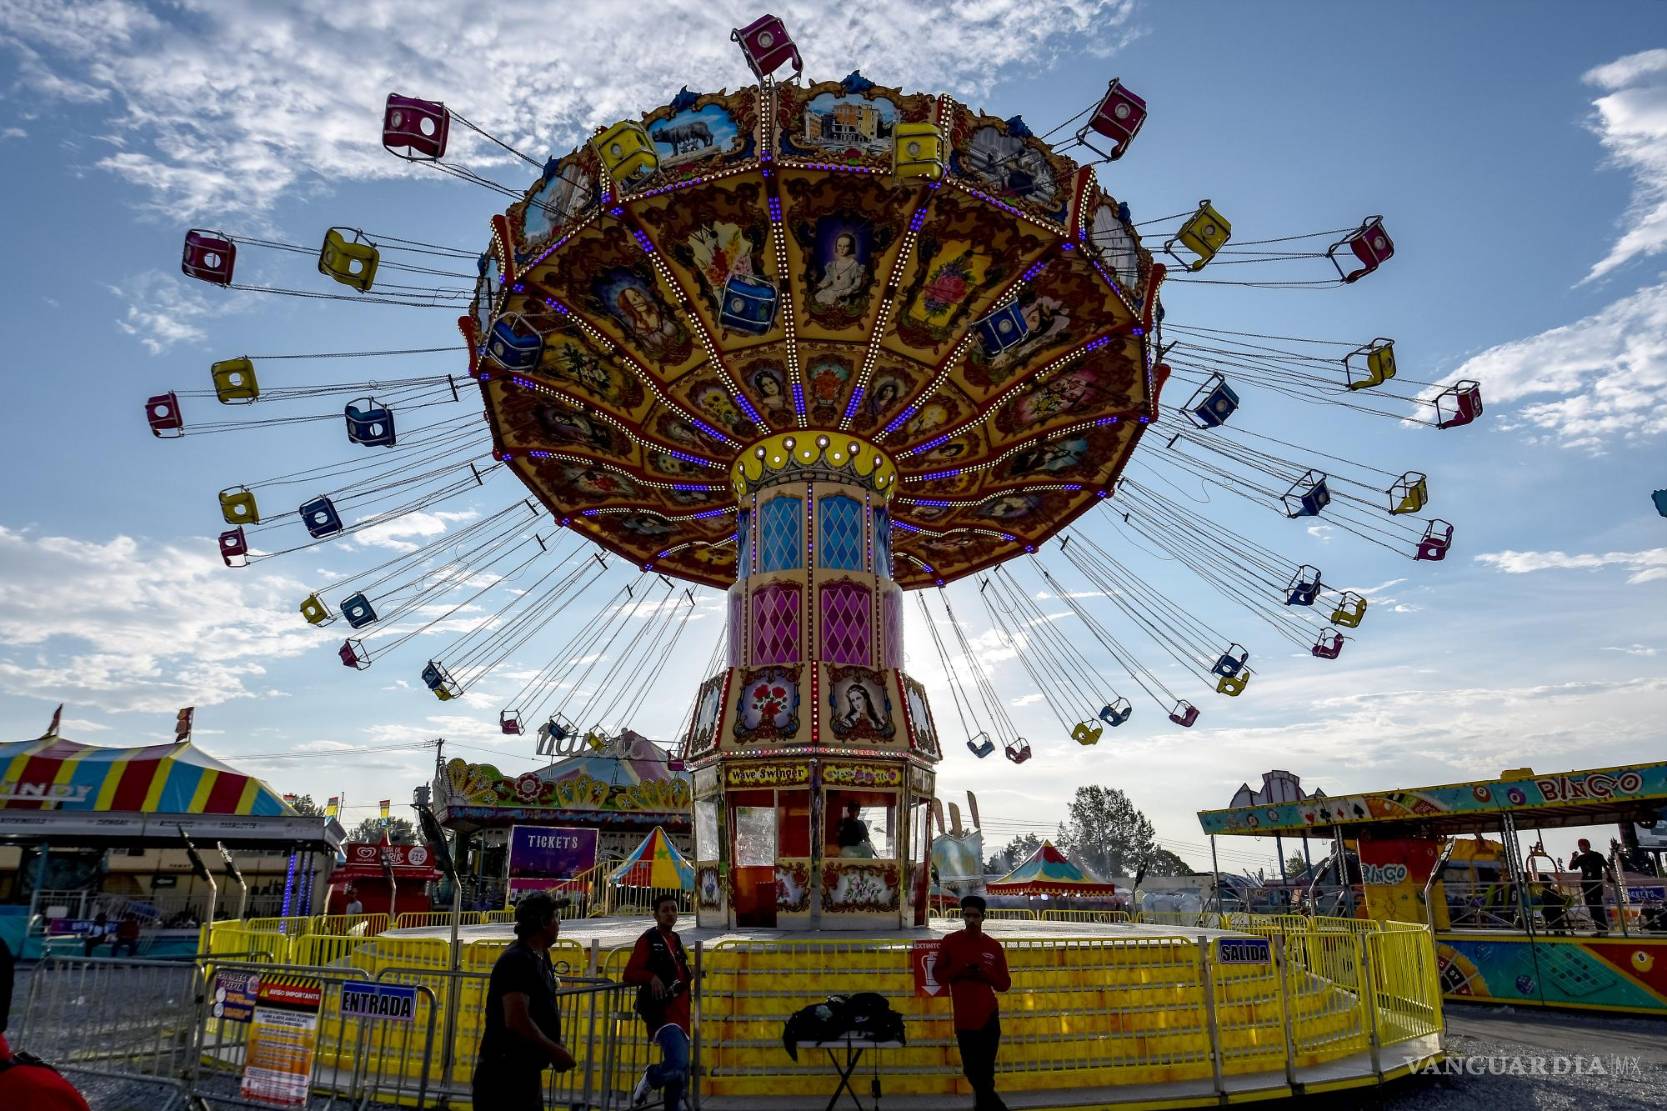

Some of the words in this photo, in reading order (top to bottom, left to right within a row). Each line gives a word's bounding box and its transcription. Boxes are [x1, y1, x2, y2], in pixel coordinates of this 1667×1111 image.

[732, 771, 756, 779] Wave
[759, 767, 804, 779] Swinger
[1535, 770, 1643, 802] BINGO
[528, 834, 579, 849] TICKETS
[1361, 863, 1408, 885] BINGO
[1221, 944, 1269, 962] SALIDA
[285, 990, 320, 1000] IMPORTANTE
[342, 991, 412, 1018] ENTRADA
